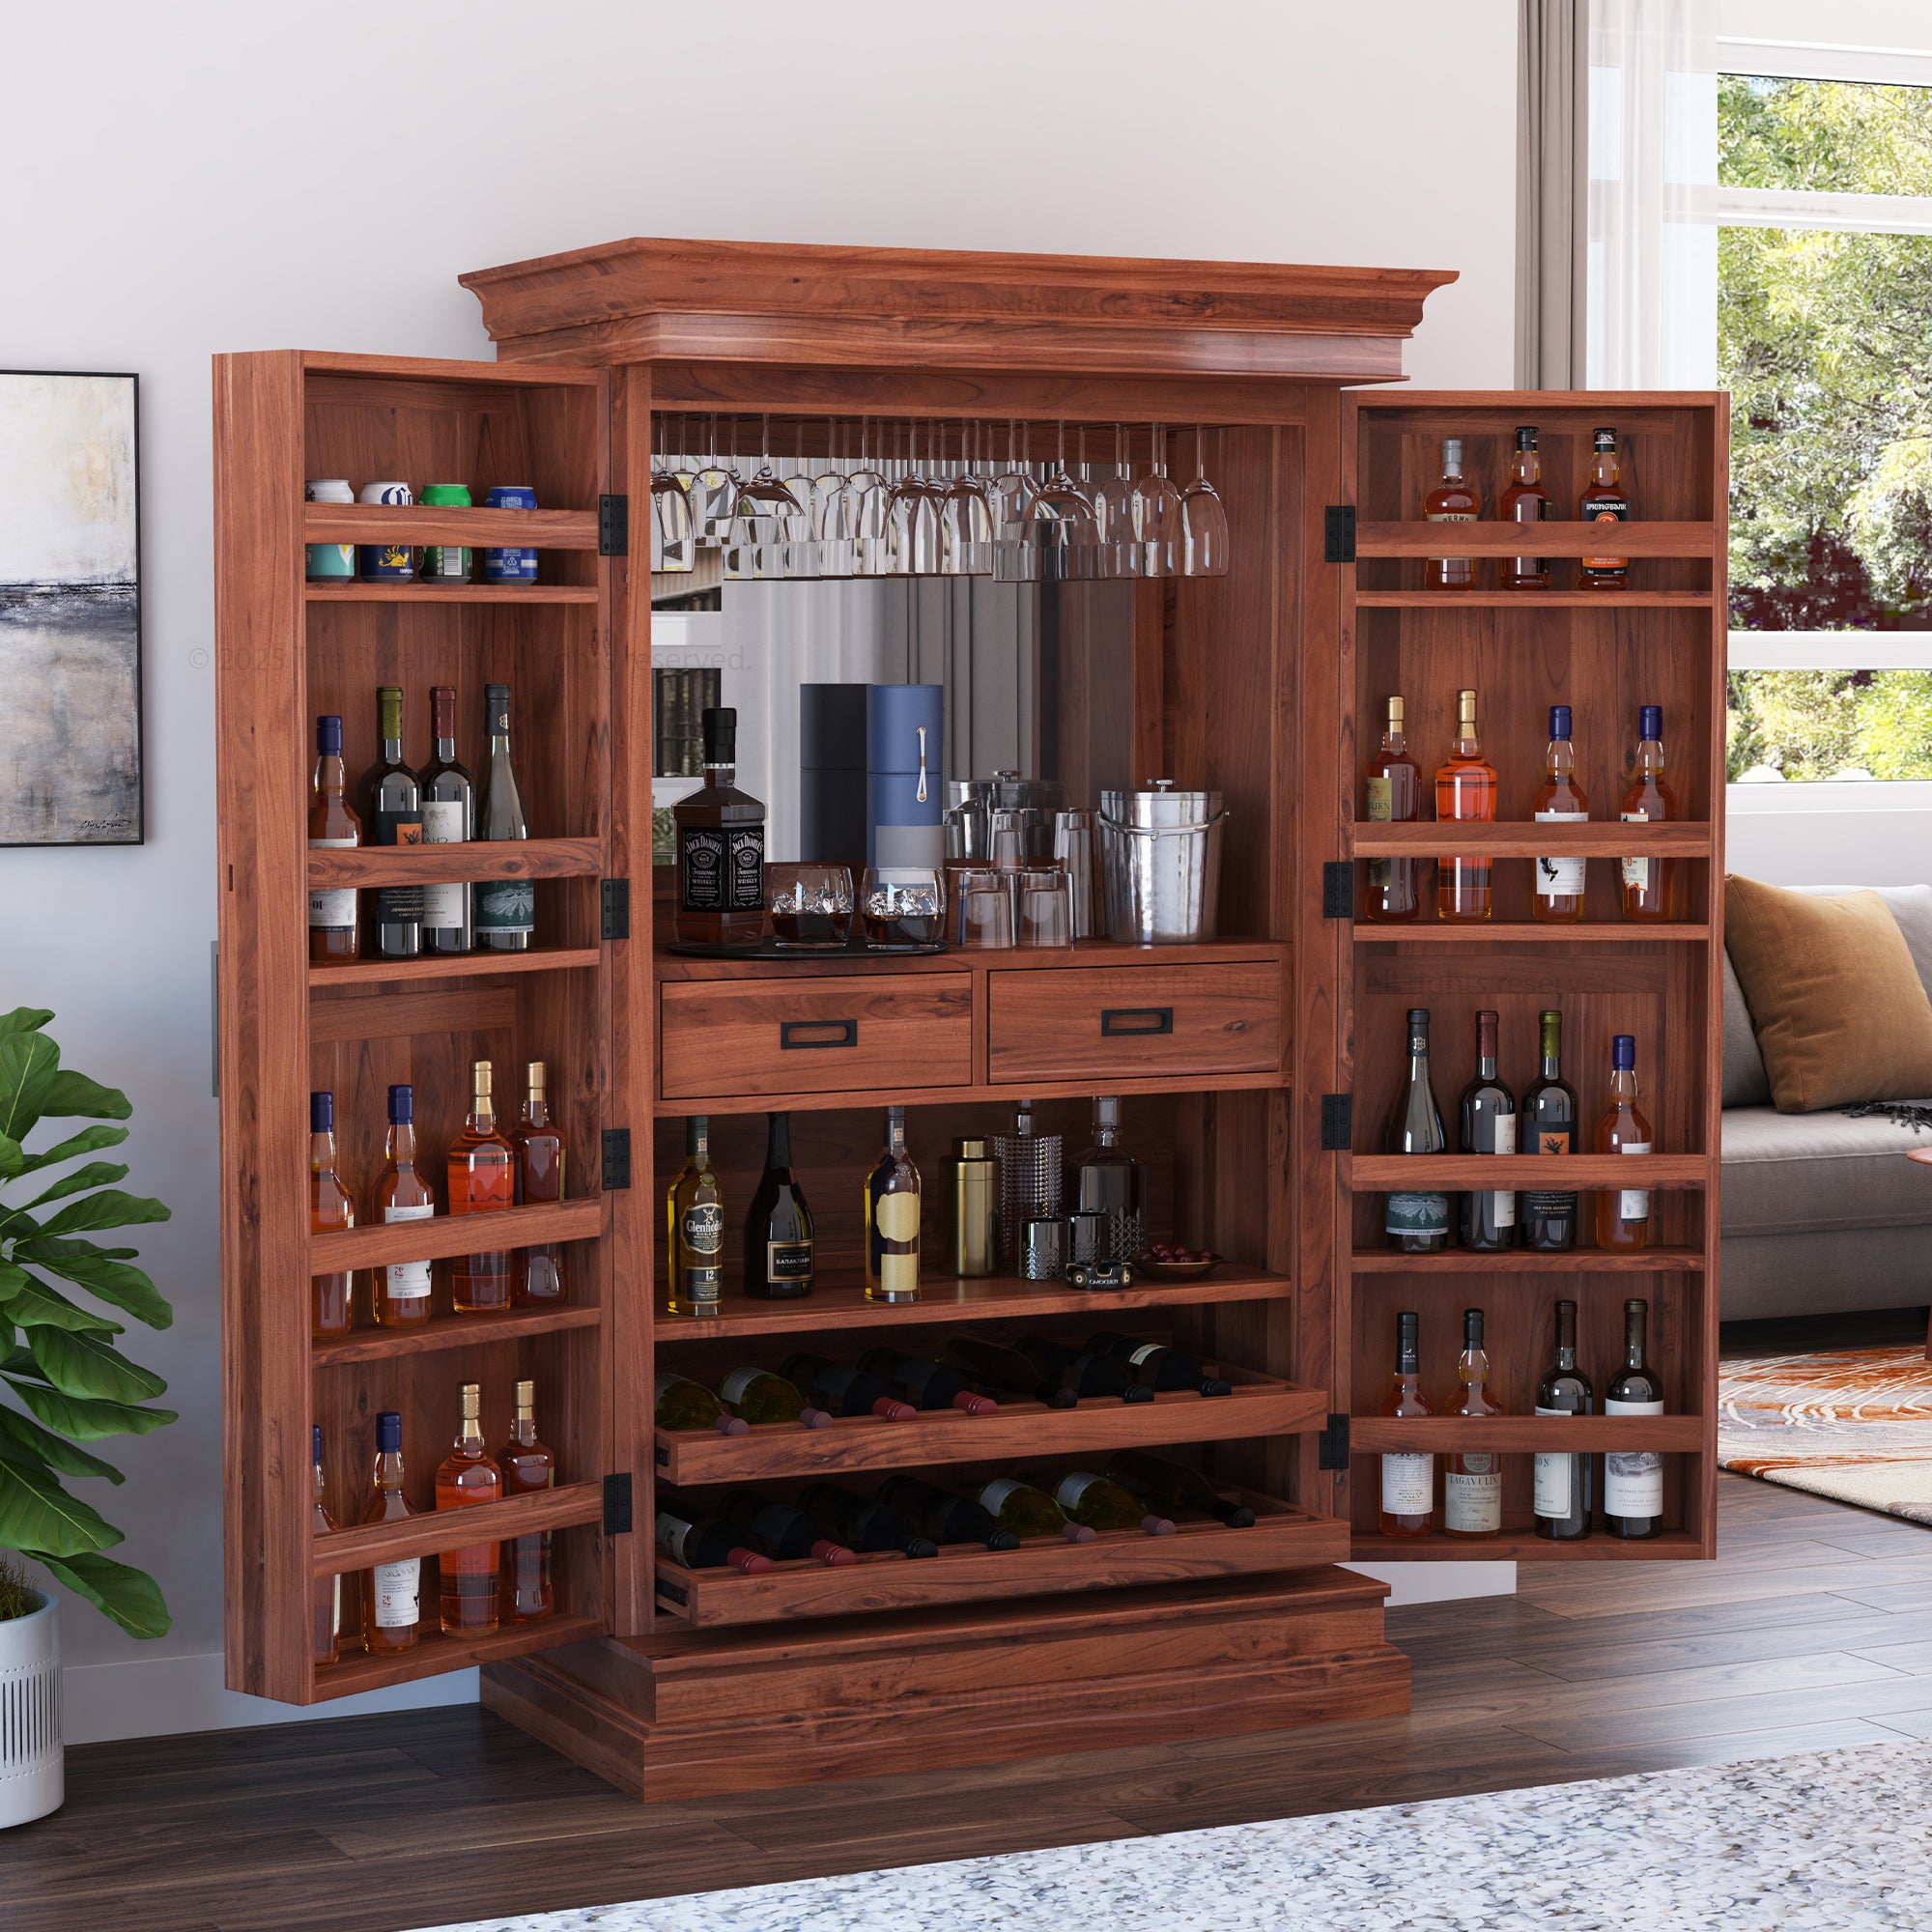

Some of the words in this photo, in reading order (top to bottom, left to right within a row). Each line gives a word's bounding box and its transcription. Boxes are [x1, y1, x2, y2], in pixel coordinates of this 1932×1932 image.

[686, 838, 699, 854] JACK
[732, 839, 744, 854] JACK
[705, 1270, 715, 1279] 12
[1450, 1476, 1497, 1485] LAGAVULIN
